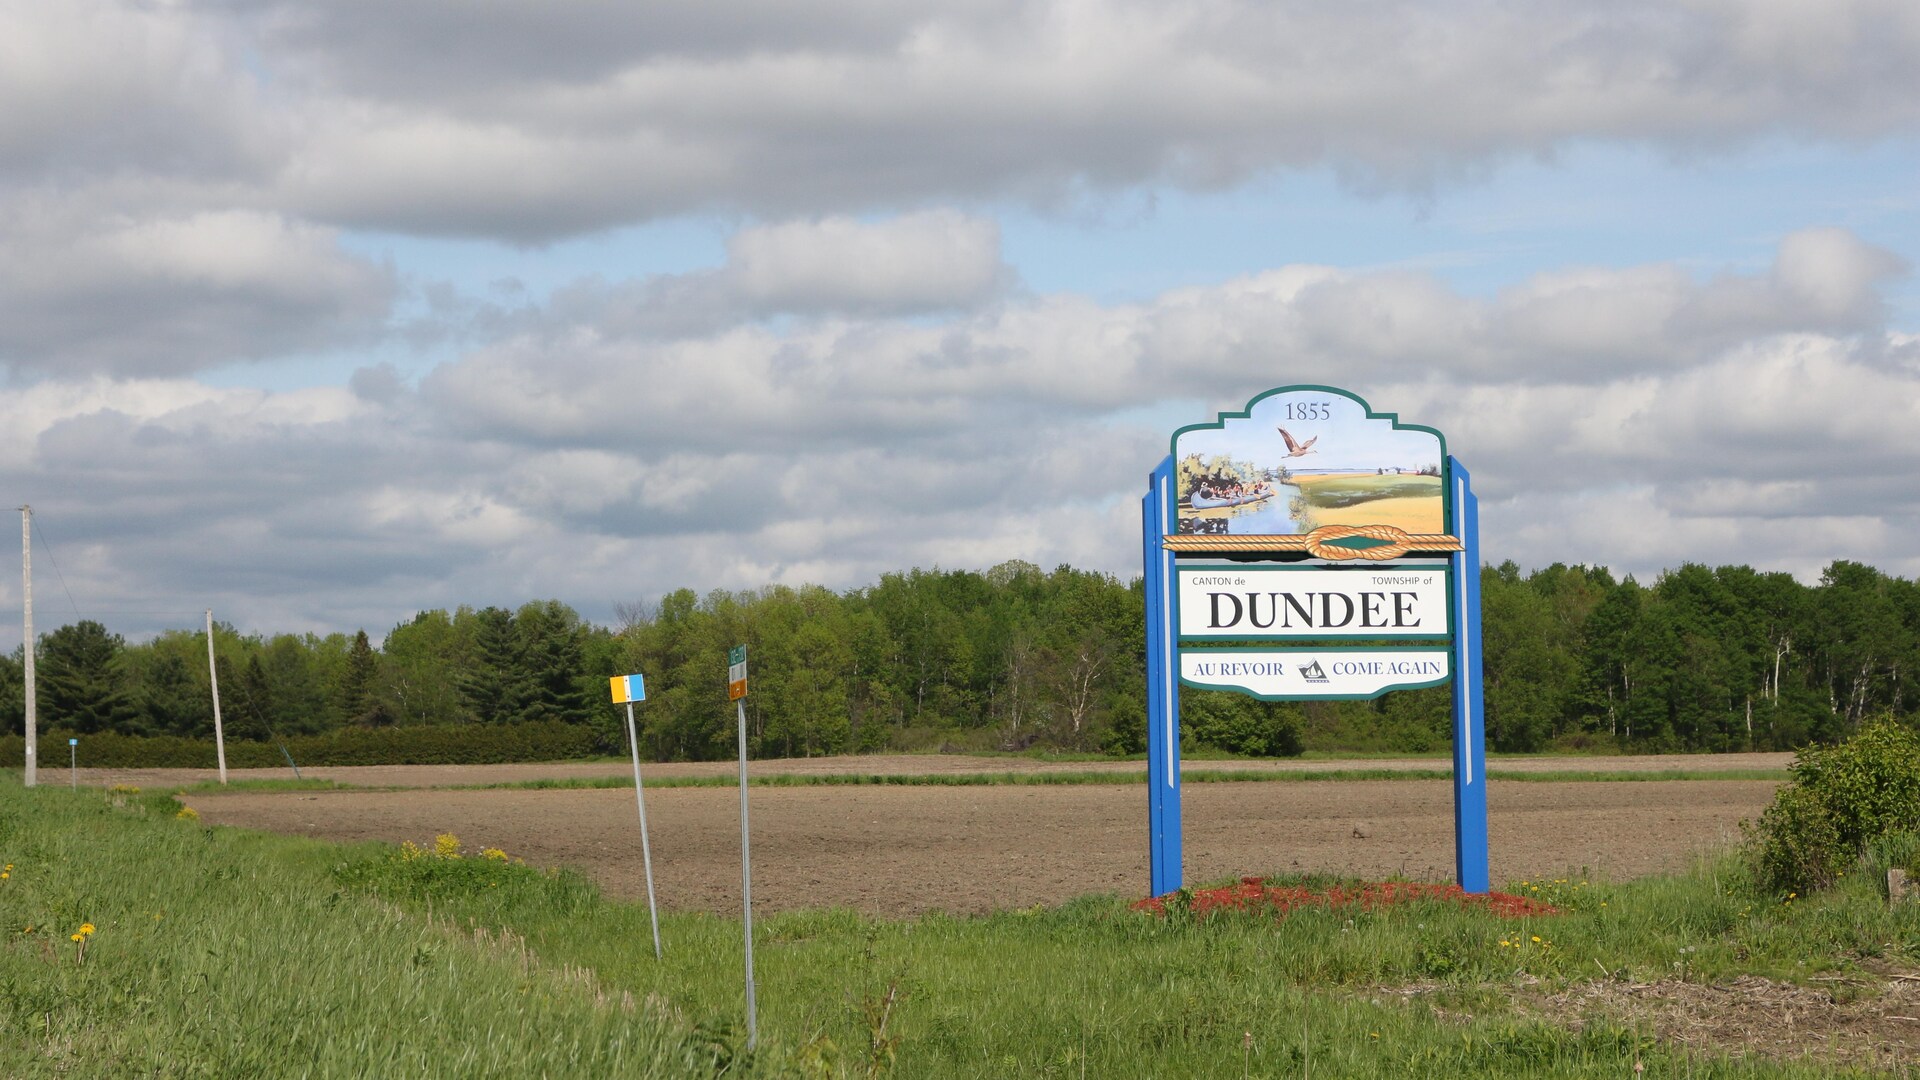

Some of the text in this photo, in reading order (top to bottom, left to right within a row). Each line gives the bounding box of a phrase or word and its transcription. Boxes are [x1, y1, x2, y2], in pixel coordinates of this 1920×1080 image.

[1285, 402, 1331, 421] 1855
[1192, 576, 1246, 586] CANTON de
[1371, 575, 1433, 585] TOWNSHIP of
[1207, 592, 1421, 628] DUNDEE
[1193, 662, 1284, 676] AU REVOIR
[1332, 661, 1441, 675] COME AGAIN
